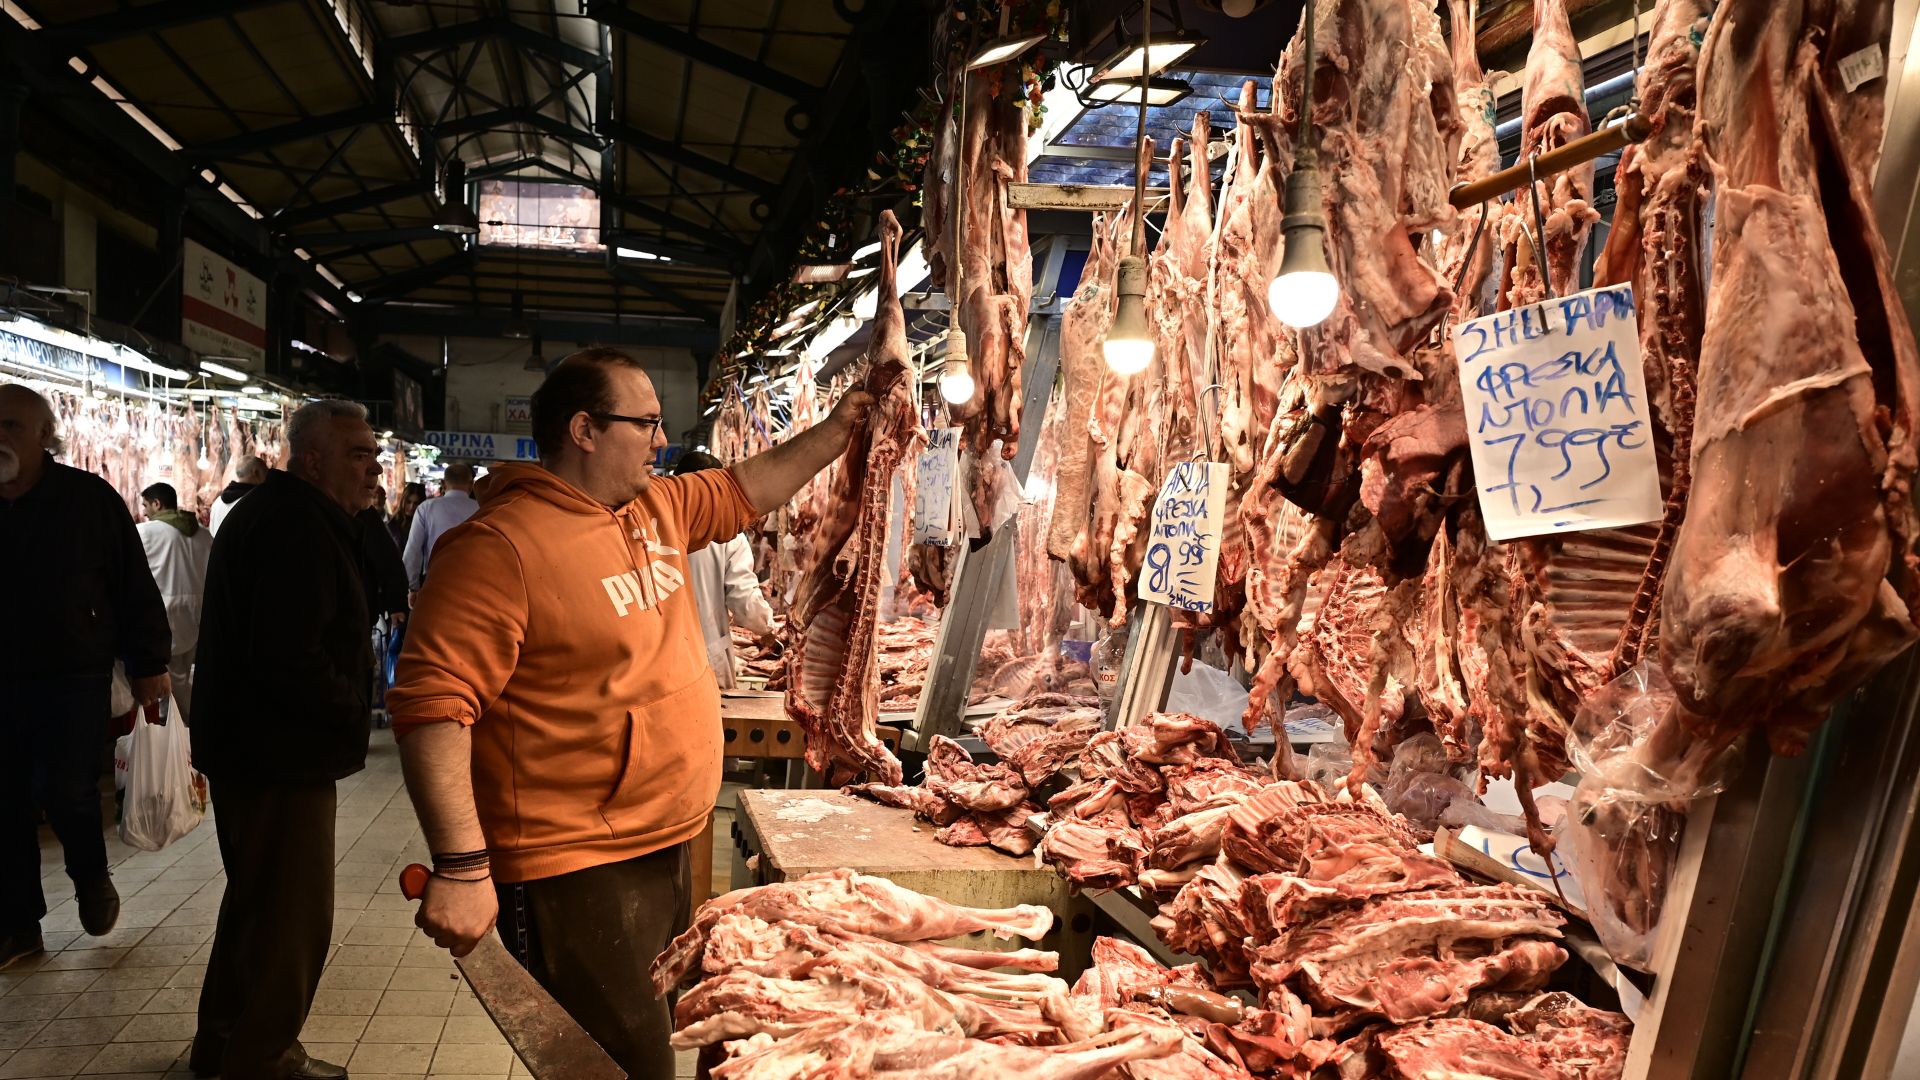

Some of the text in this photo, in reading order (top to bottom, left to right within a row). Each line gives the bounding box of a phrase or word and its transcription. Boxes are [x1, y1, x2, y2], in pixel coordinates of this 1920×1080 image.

[1476, 340, 1627, 403] ΦΡΕΣΚΑ
[1477, 371, 1636, 434] ΝΤΟΠΙΑ
[426, 432, 495, 449] ΟΙΡΙΝΑ
[1483, 420, 1647, 516] 7,99€
[1098, 673, 1116, 682] ΚΟΣ
